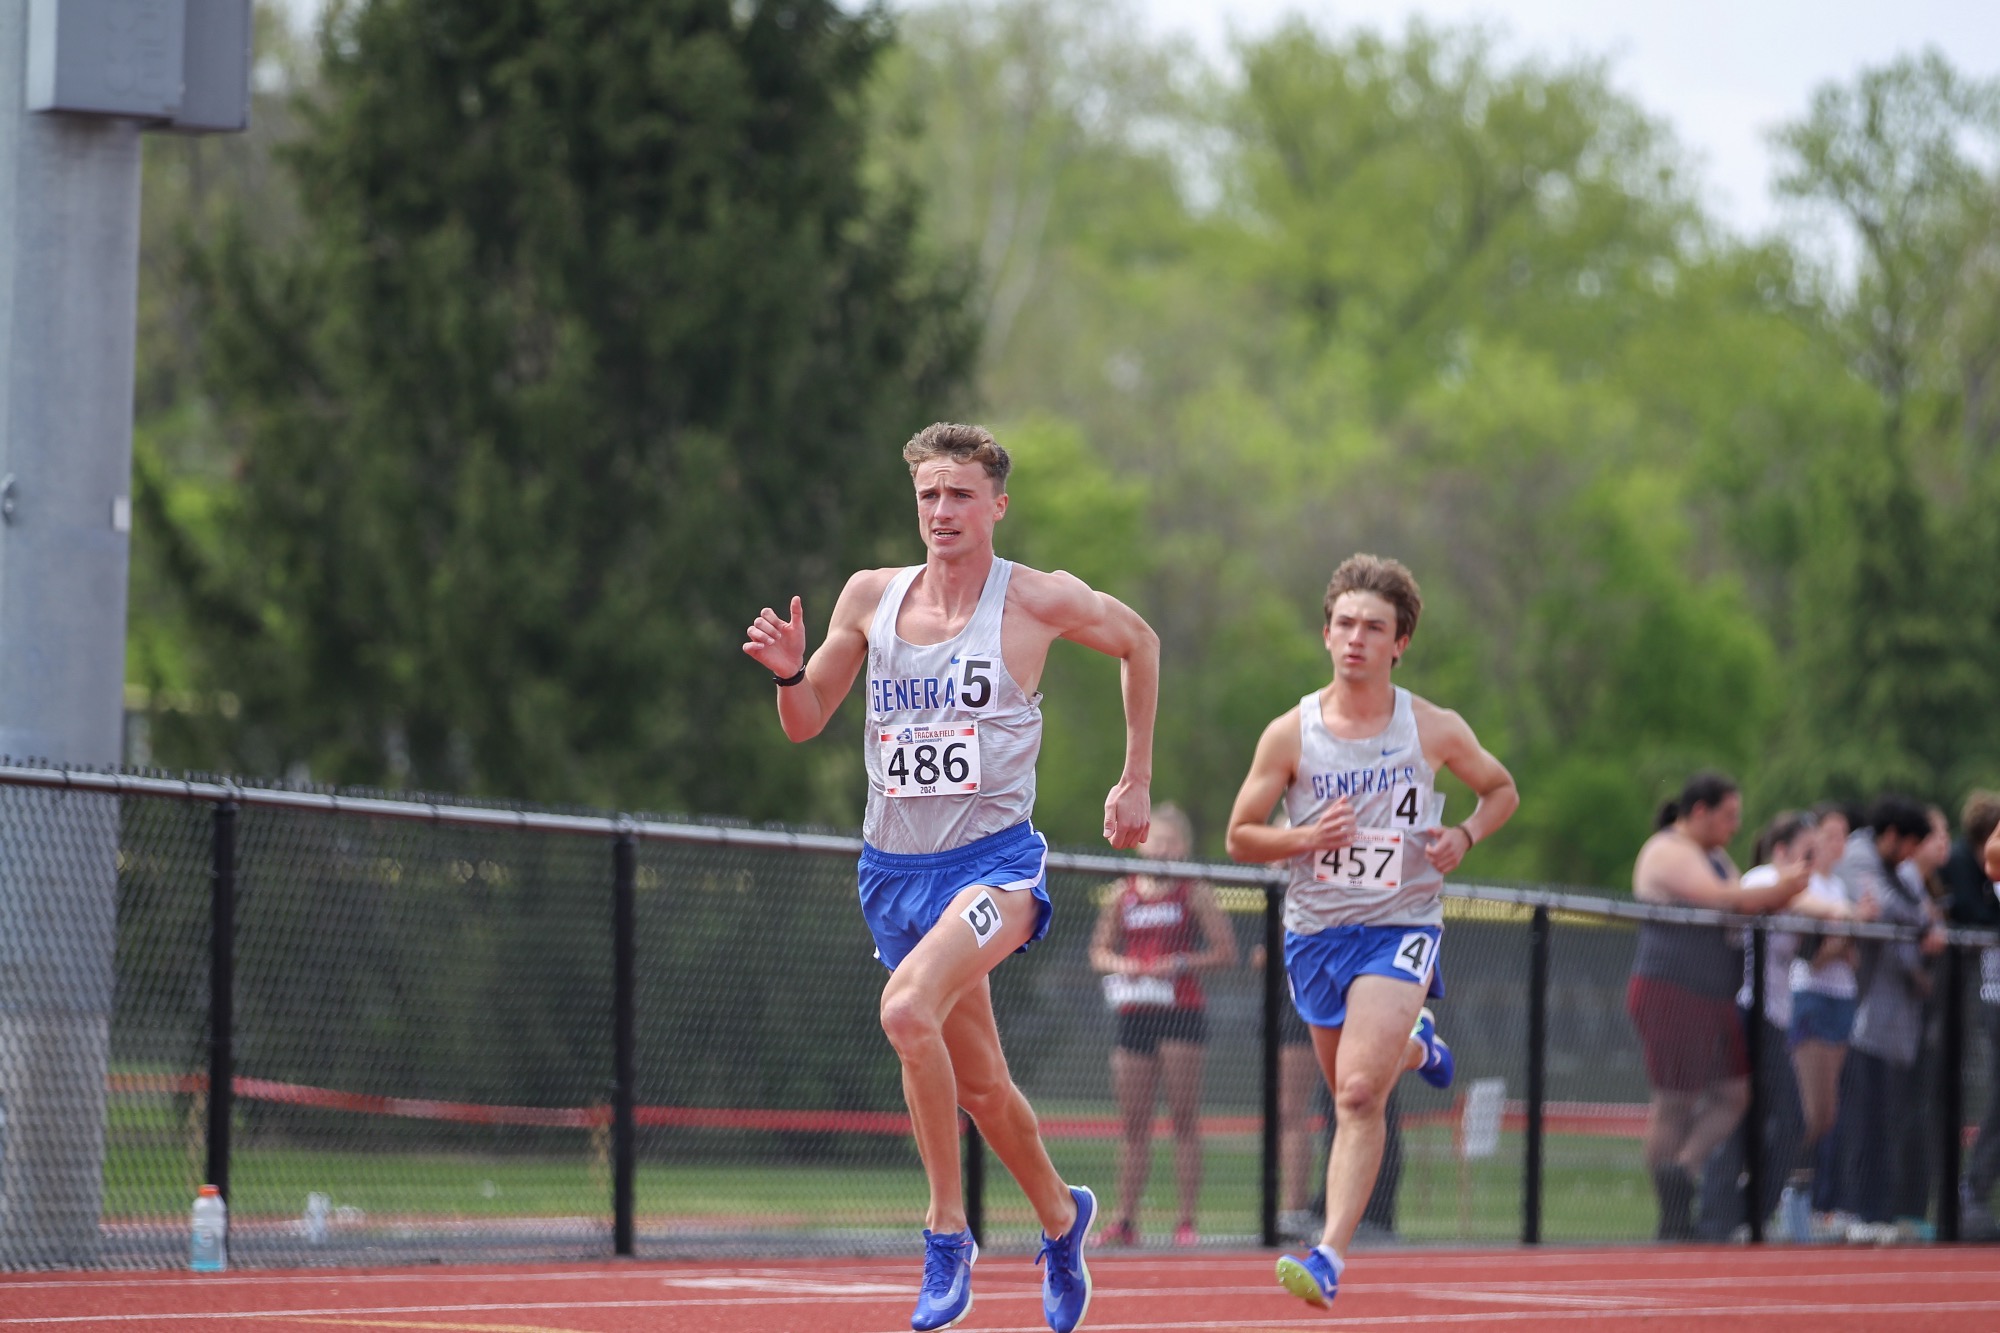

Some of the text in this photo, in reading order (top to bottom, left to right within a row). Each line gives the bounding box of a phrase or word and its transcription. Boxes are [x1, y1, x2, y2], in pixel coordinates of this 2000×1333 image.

[872, 677, 955, 712] GENERA
[961, 660, 992, 708] 5
[914, 729, 955, 740] TRACK&FIELD
[887, 743, 970, 785] 486
[1396, 787, 1419, 825] 4
[1321, 846, 1395, 879] 457
[968, 896, 999, 936] 5
[1401, 936, 1427, 970] 4
